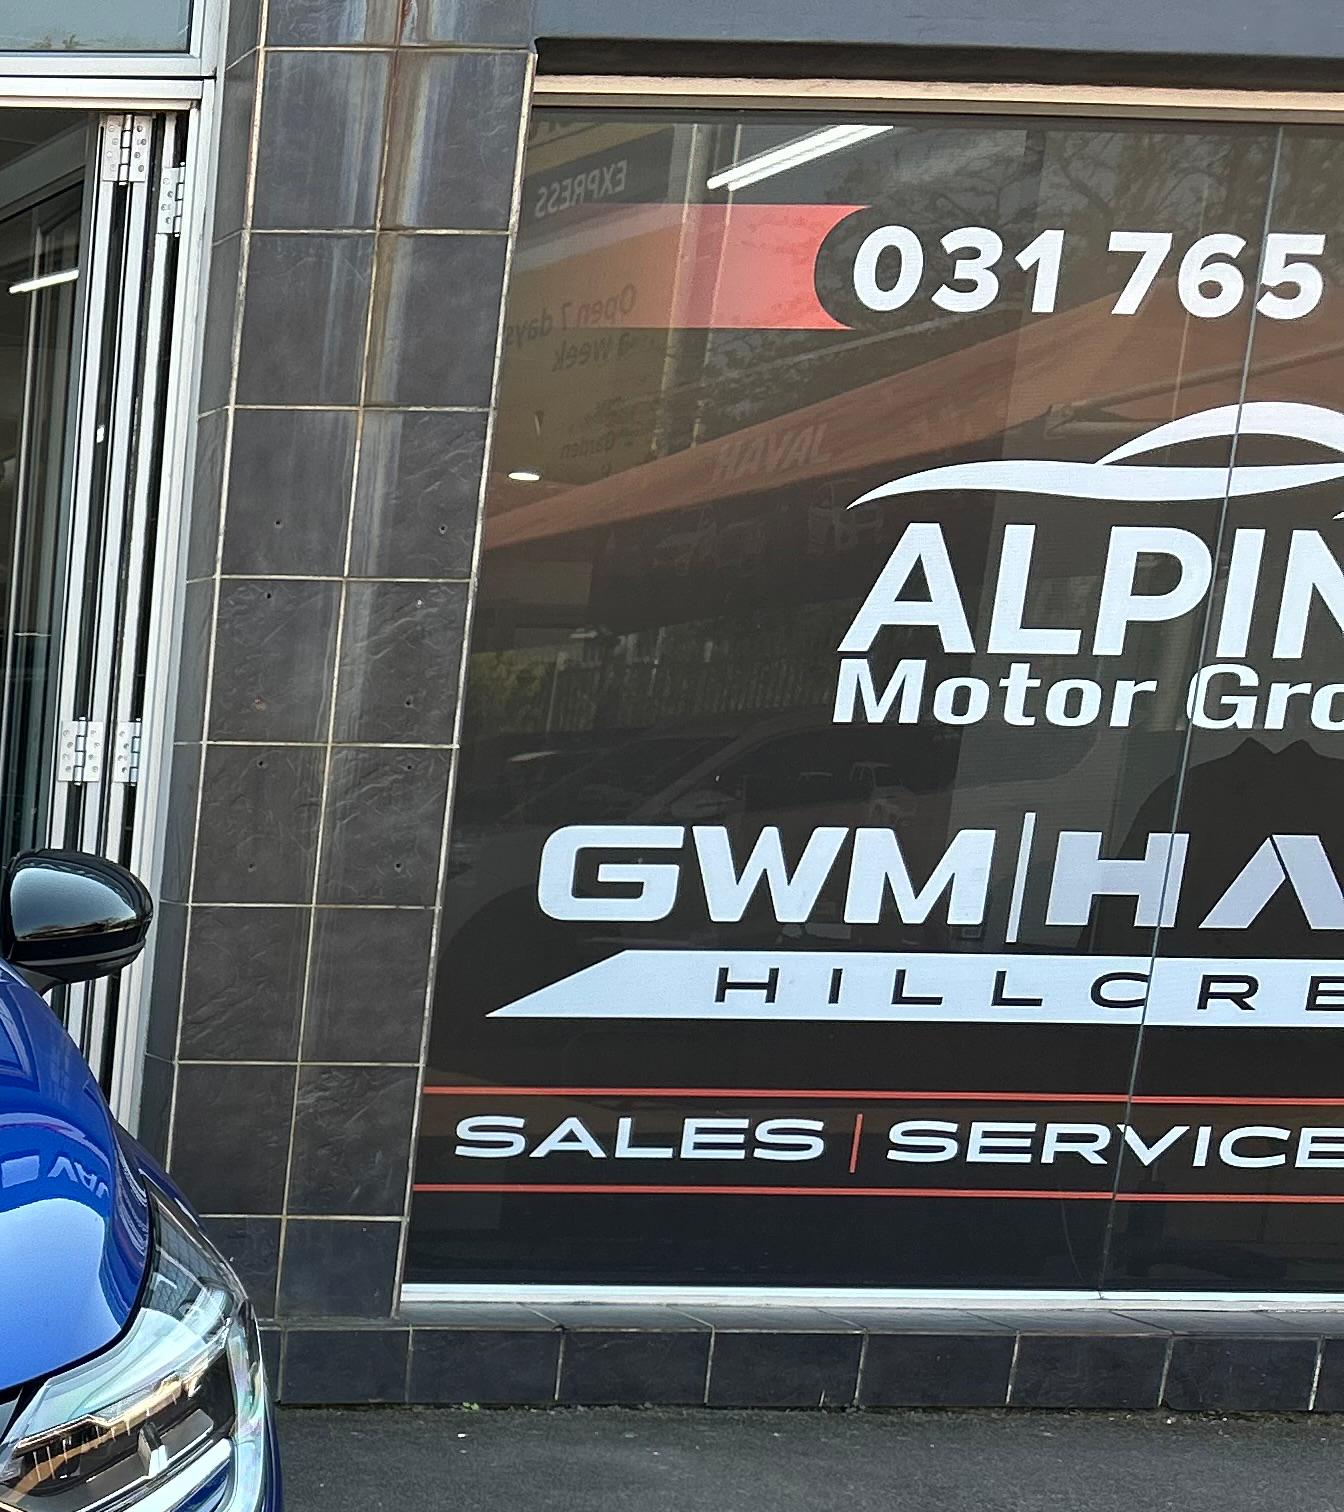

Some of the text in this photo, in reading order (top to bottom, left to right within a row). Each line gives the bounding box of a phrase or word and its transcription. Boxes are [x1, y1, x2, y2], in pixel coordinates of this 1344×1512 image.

[853, 225, 1326, 319] 031 765
[832, 658, 1158, 727] Motor
[538, 825, 997, 925] GWM
[714, 966, 1344, 1011] HILLCRE
[454, 1115, 1344, 1168] SALES SERVICE
